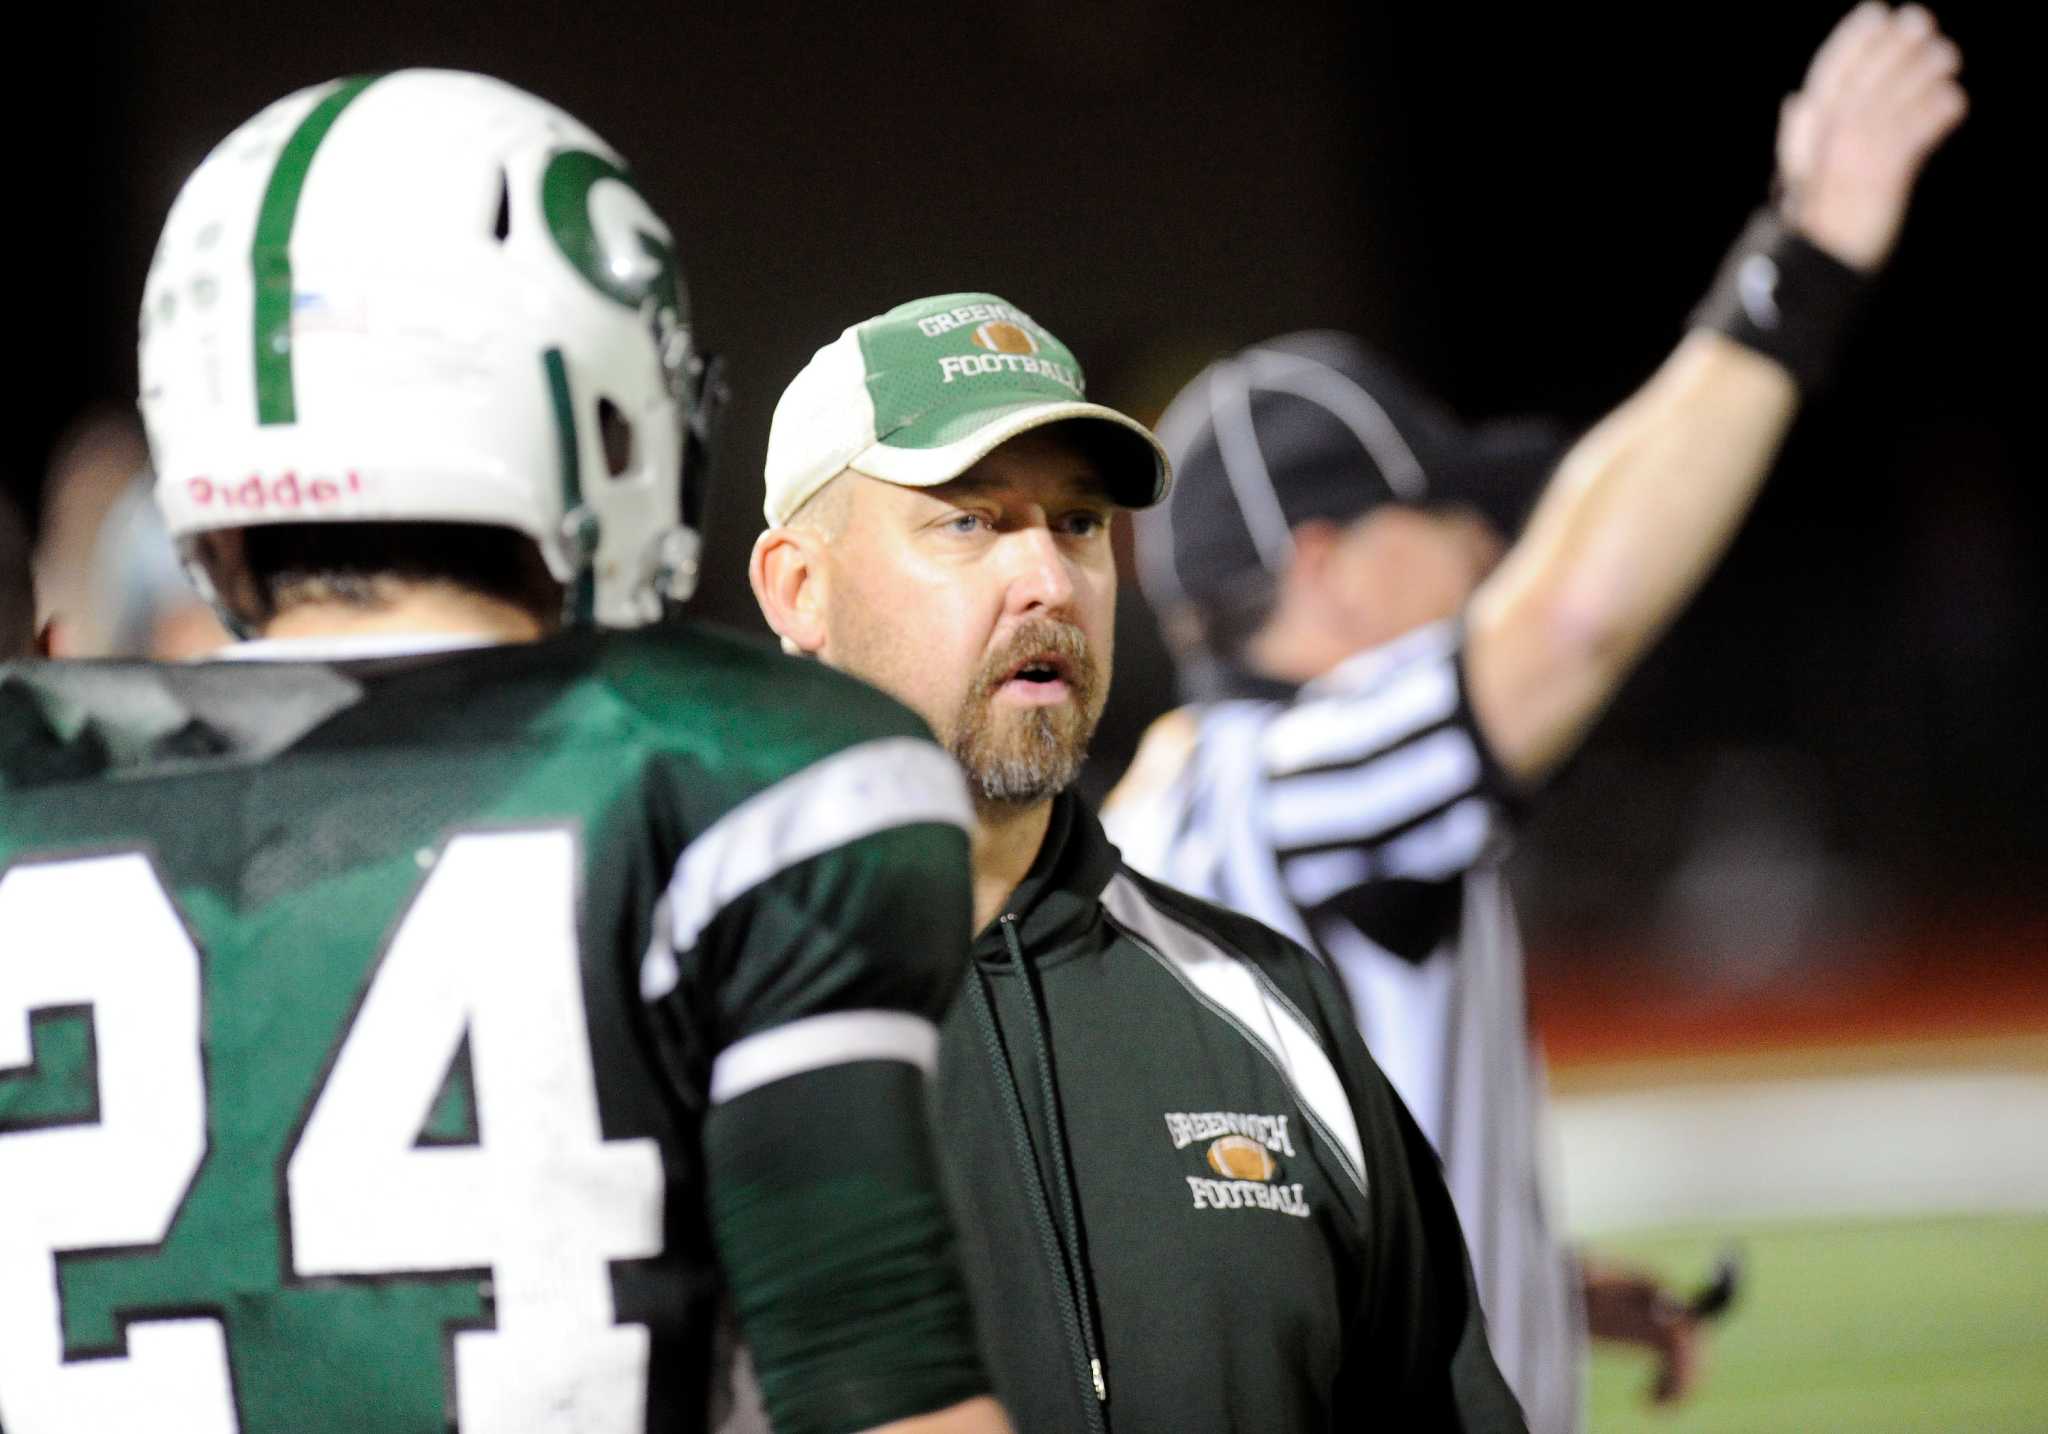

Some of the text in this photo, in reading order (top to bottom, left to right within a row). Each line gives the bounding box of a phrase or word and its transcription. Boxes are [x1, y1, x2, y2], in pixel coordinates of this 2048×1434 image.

[918, 302, 1058, 338] GREEN
[0, 824, 666, 1434] 24
[1164, 1111, 1296, 1158] GREENWICH
[1185, 1175, 1311, 1218] FOOTBALL
